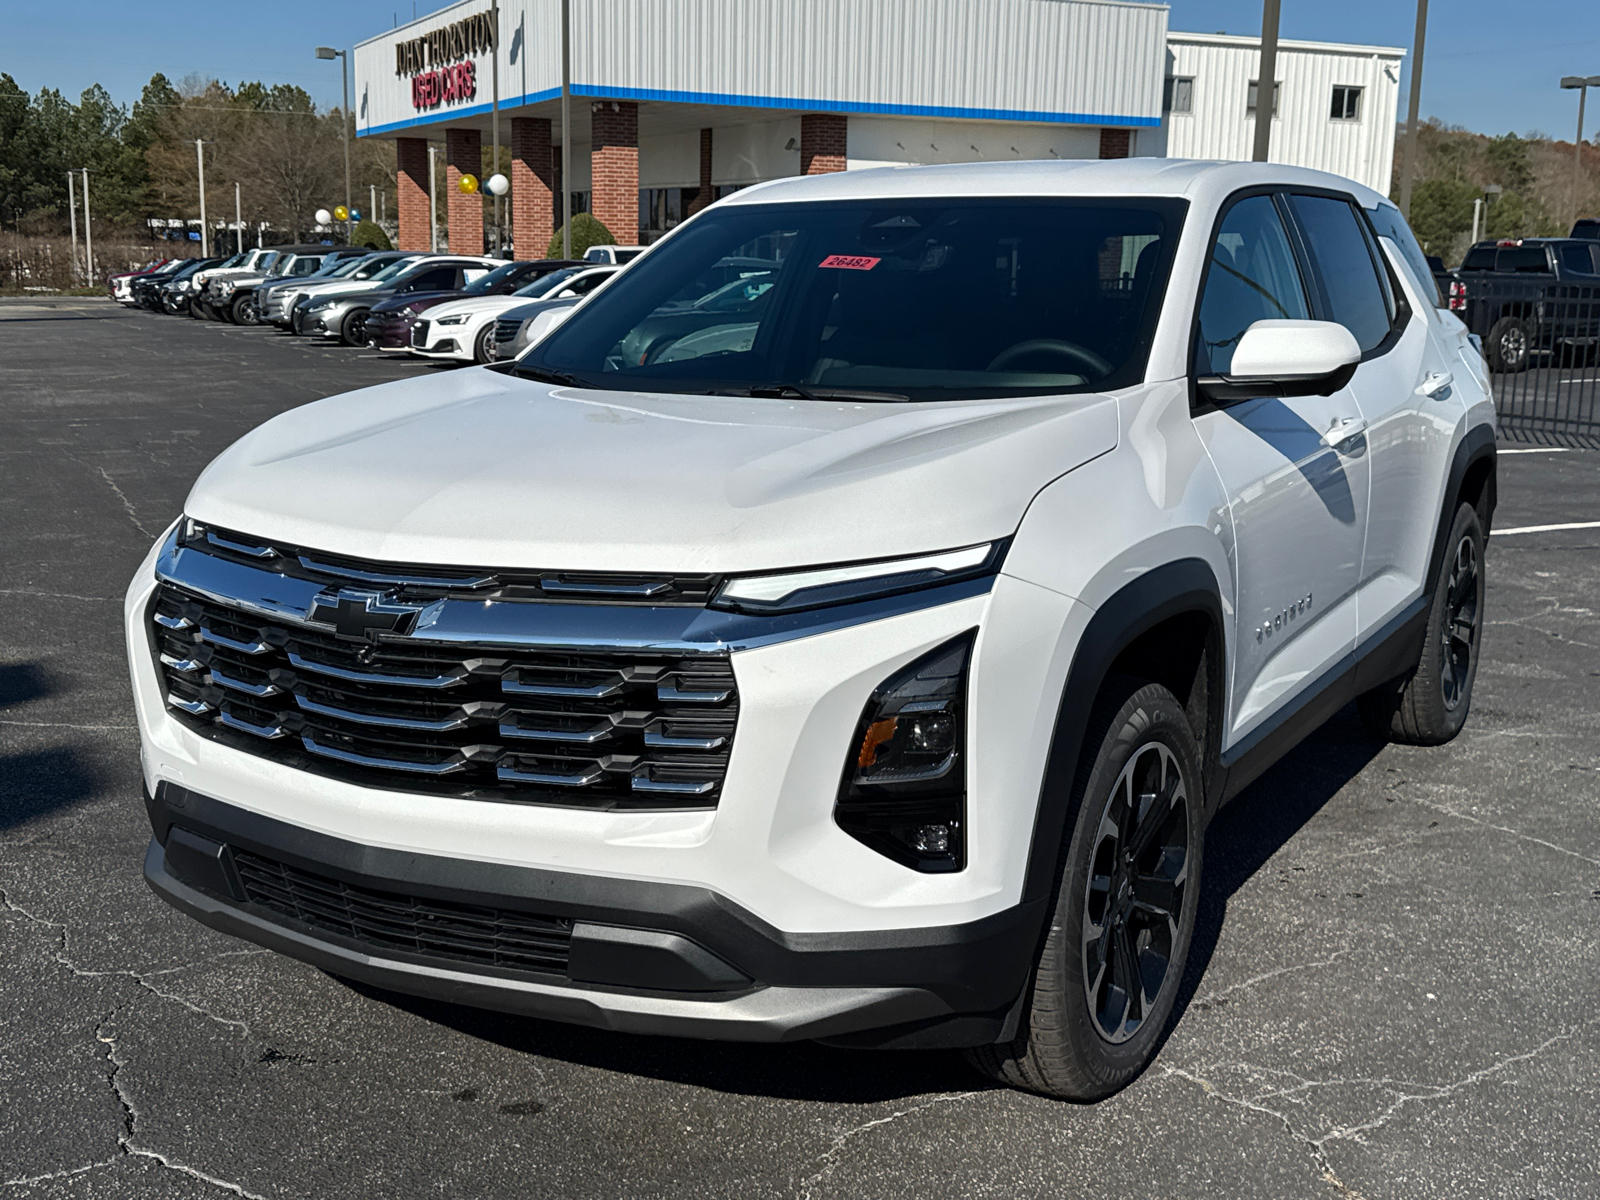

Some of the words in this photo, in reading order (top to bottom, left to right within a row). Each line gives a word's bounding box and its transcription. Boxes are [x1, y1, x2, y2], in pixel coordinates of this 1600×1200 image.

[395, 36, 424, 76] JOHN
[425, 8, 499, 67] THORNTON
[412, 71, 440, 108] USED
[441, 60, 474, 102] CARS
[827, 257, 871, 267] 26482
